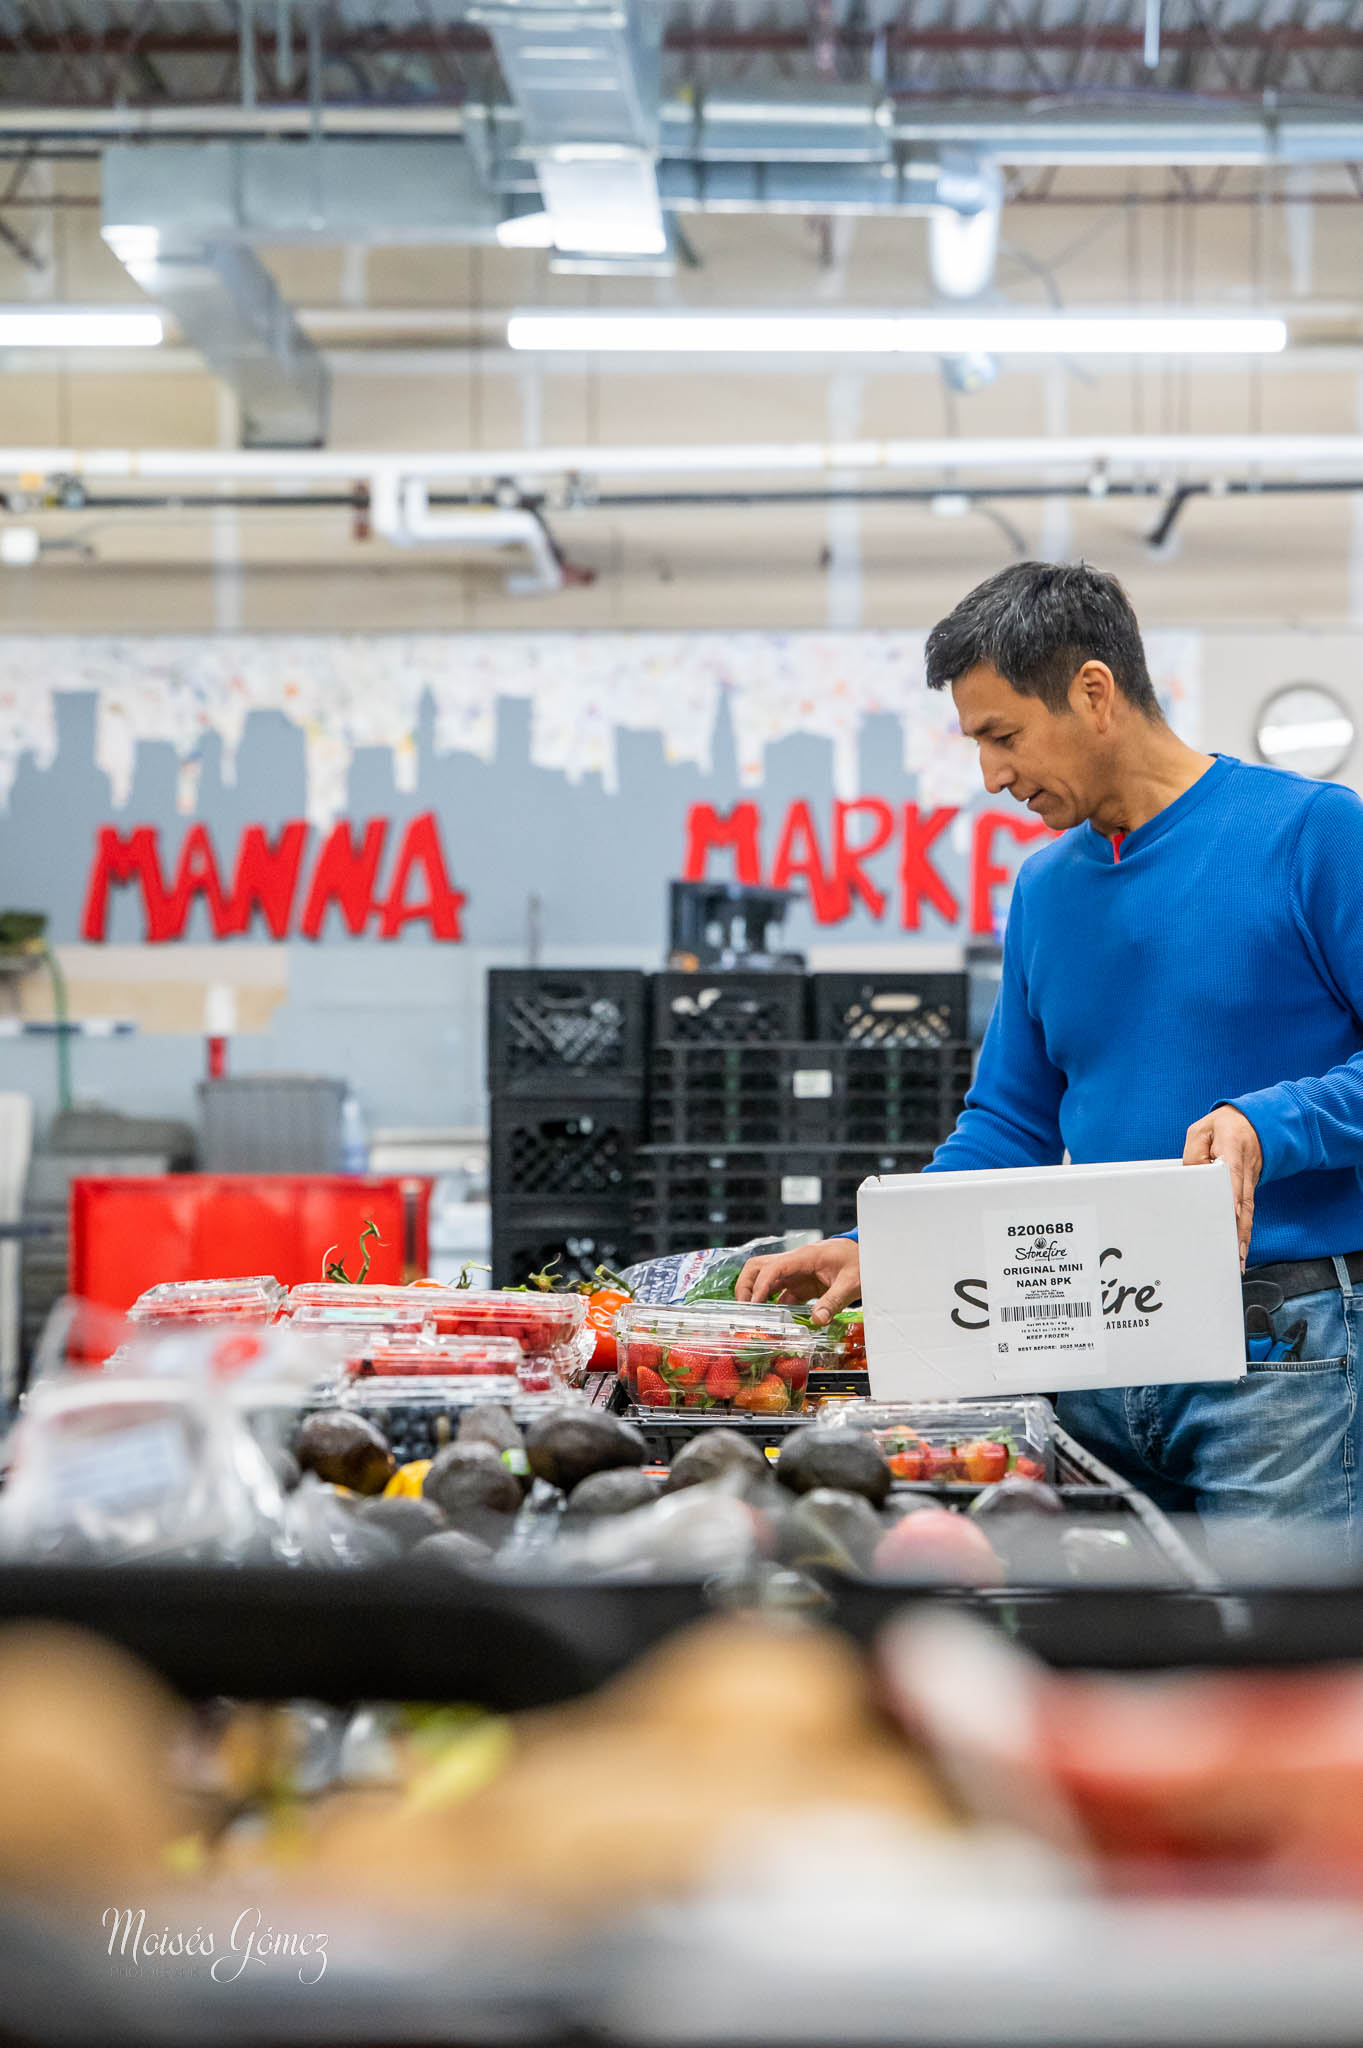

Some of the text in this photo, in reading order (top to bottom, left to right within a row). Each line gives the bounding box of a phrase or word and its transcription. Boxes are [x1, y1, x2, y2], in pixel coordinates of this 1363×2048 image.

[81, 809, 467, 942] MANNA
[1007, 1222, 1074, 1237] 8200688
[1015, 1240, 1068, 1261] Stonefire
[1003, 1263, 1083, 1276] ORIGINAL MINI
[1016, 1277, 1072, 1288] NAAN 8PK
[1104, 1319, 1150, 1330] ATBREADS
